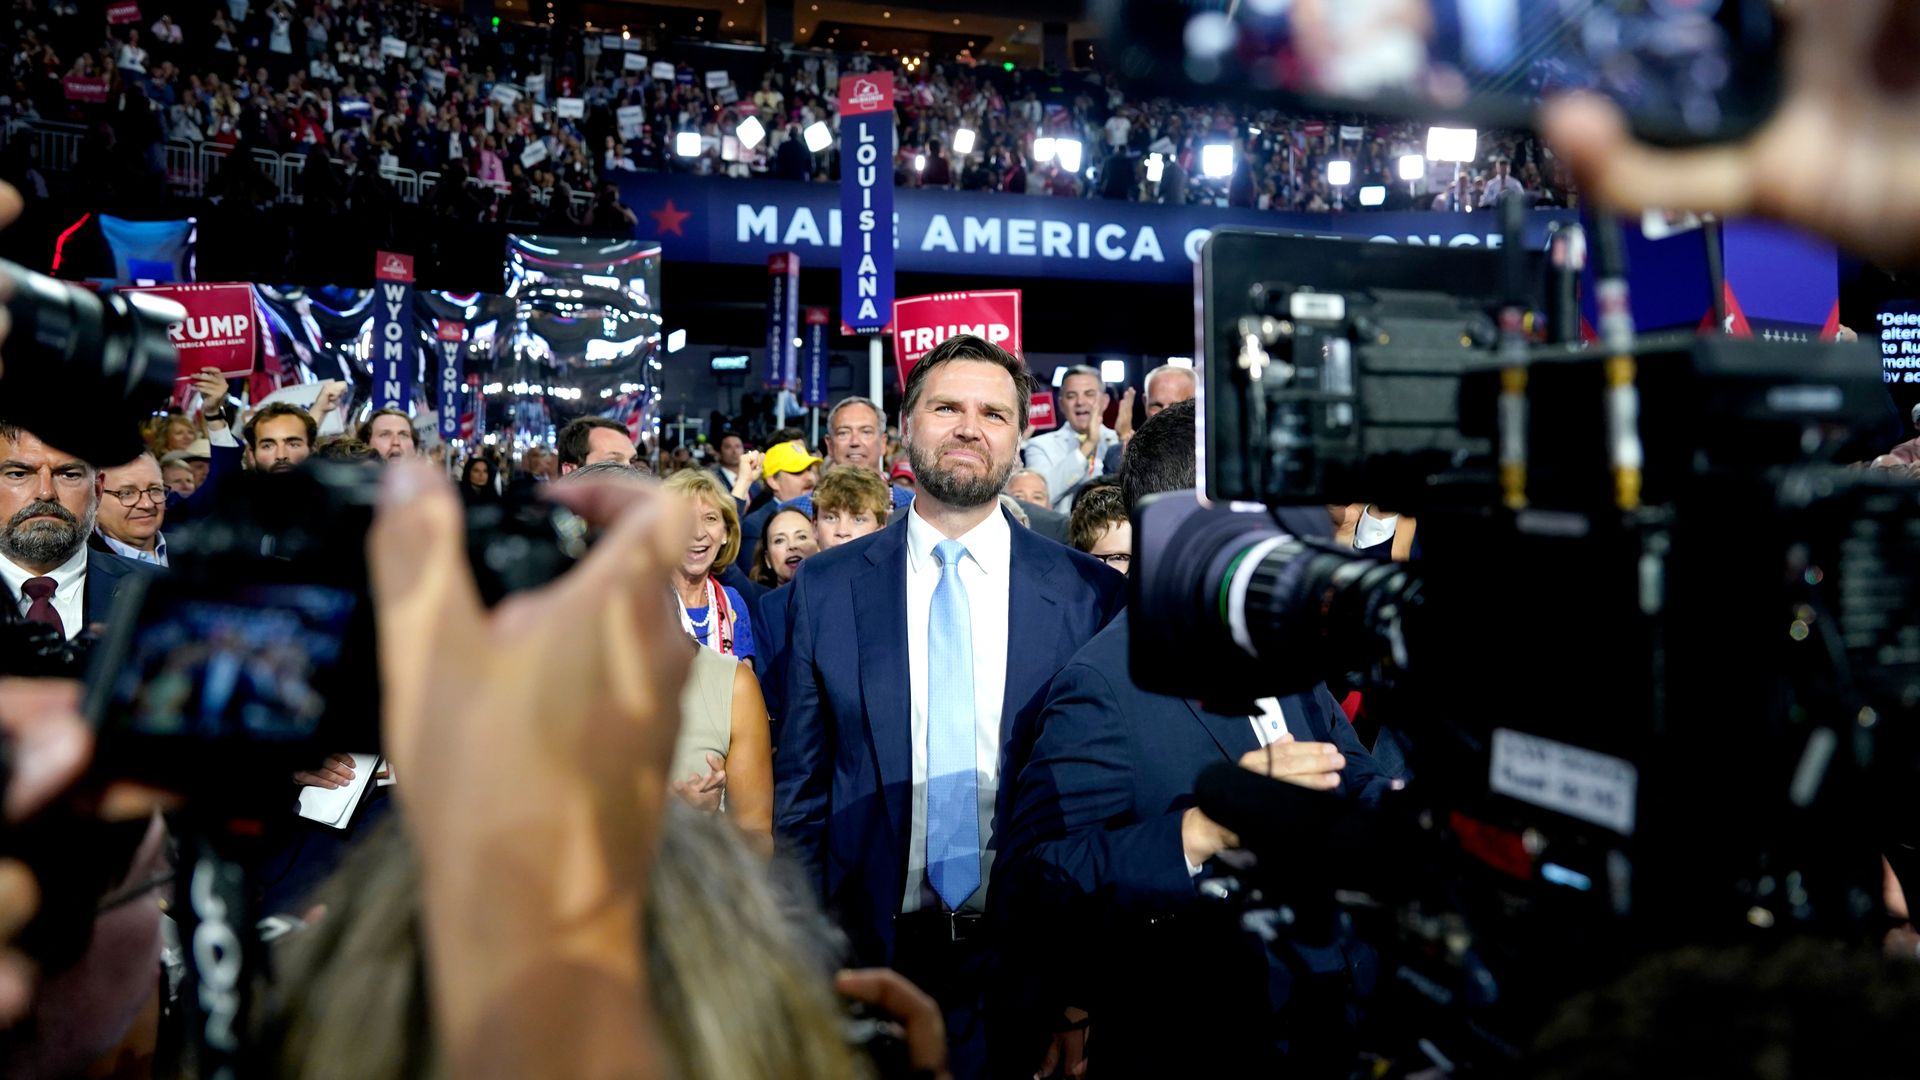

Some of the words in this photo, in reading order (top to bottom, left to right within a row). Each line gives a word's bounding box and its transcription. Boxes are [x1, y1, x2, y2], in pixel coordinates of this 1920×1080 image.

[737, 204, 899, 249] MA
[920, 214, 1165, 263] AMERICA
[856, 122, 878, 319] LOUISIANA
[168, 315, 249, 341] RUMP
[1882, 342, 1898, 354] to
[443, 342, 458, 432] WYOMING
